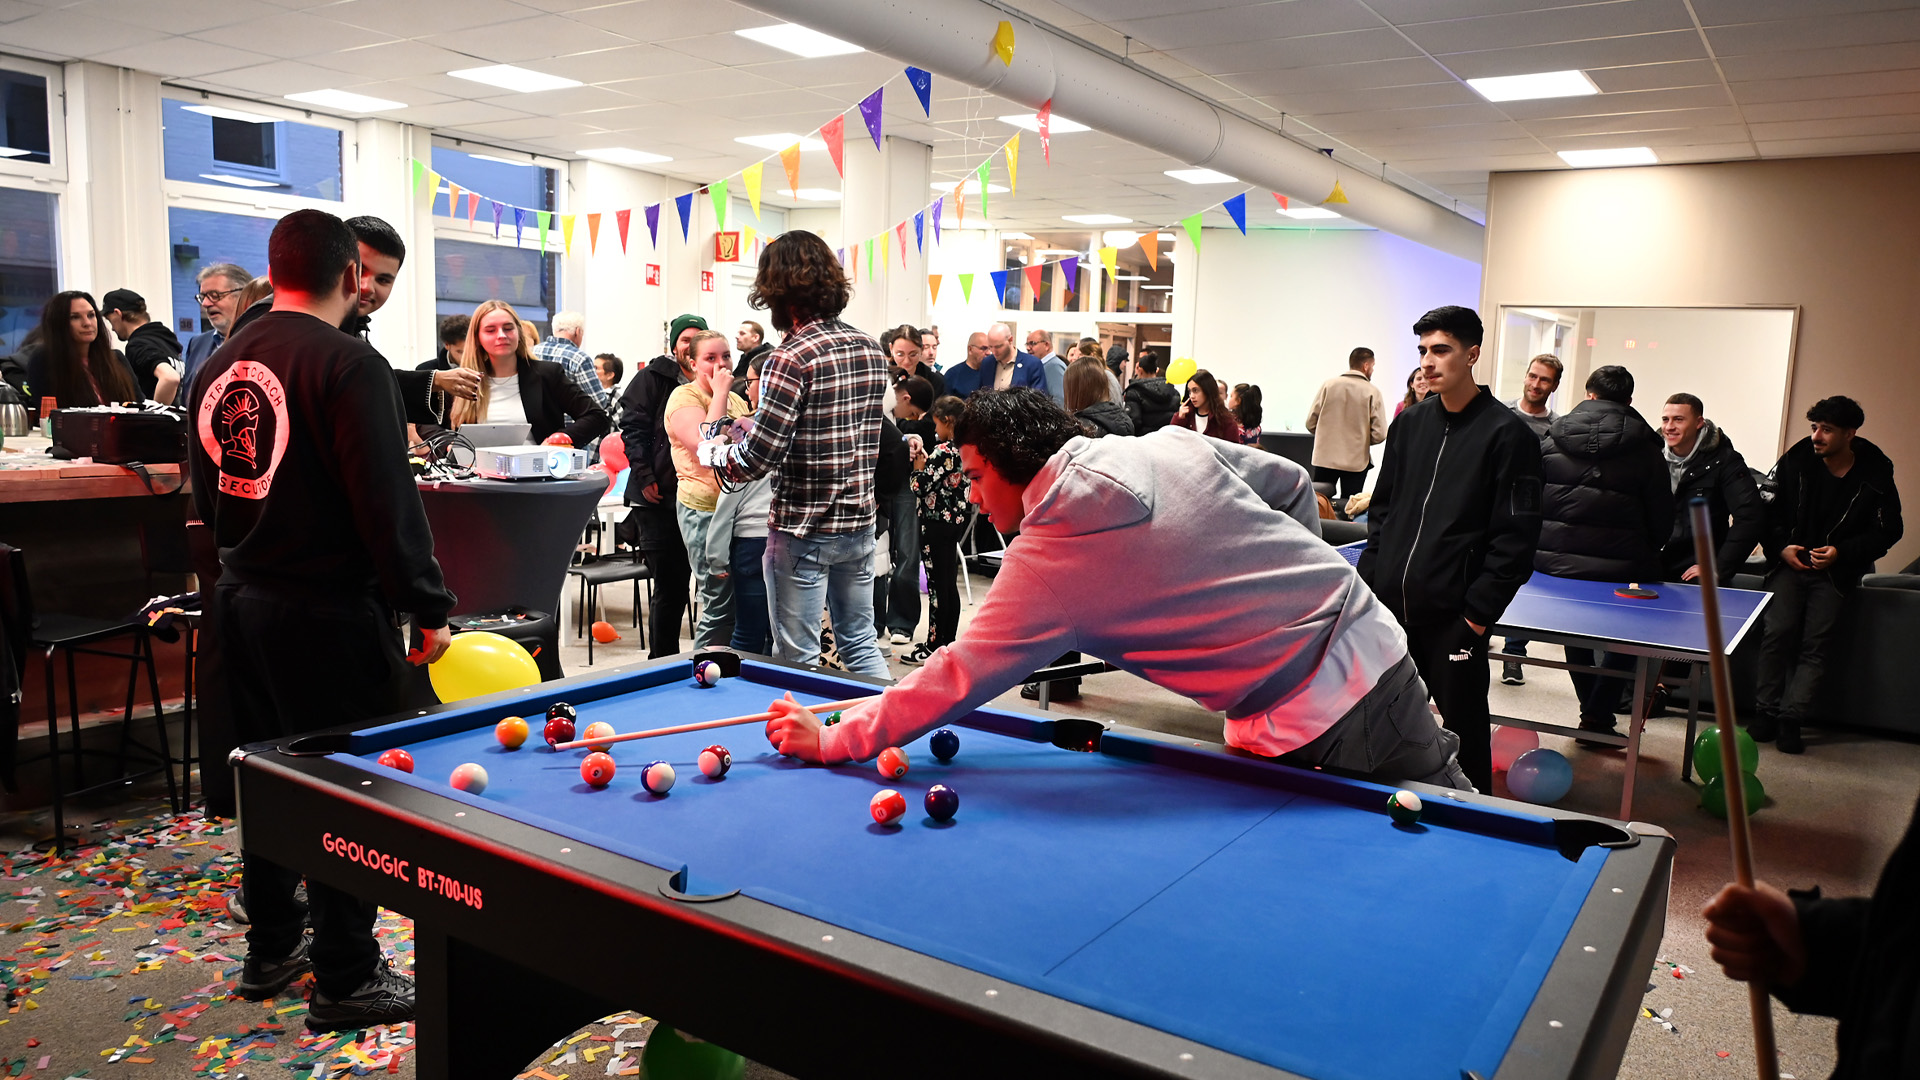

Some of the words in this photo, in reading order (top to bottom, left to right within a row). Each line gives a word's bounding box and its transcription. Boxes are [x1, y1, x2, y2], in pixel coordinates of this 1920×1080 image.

[204, 366, 283, 412] STRATCOACH
[1448, 653, 1469, 662] PUMA
[322, 832, 410, 882] GEOLOGIC
[417, 866, 483, 910] BT-700-US
